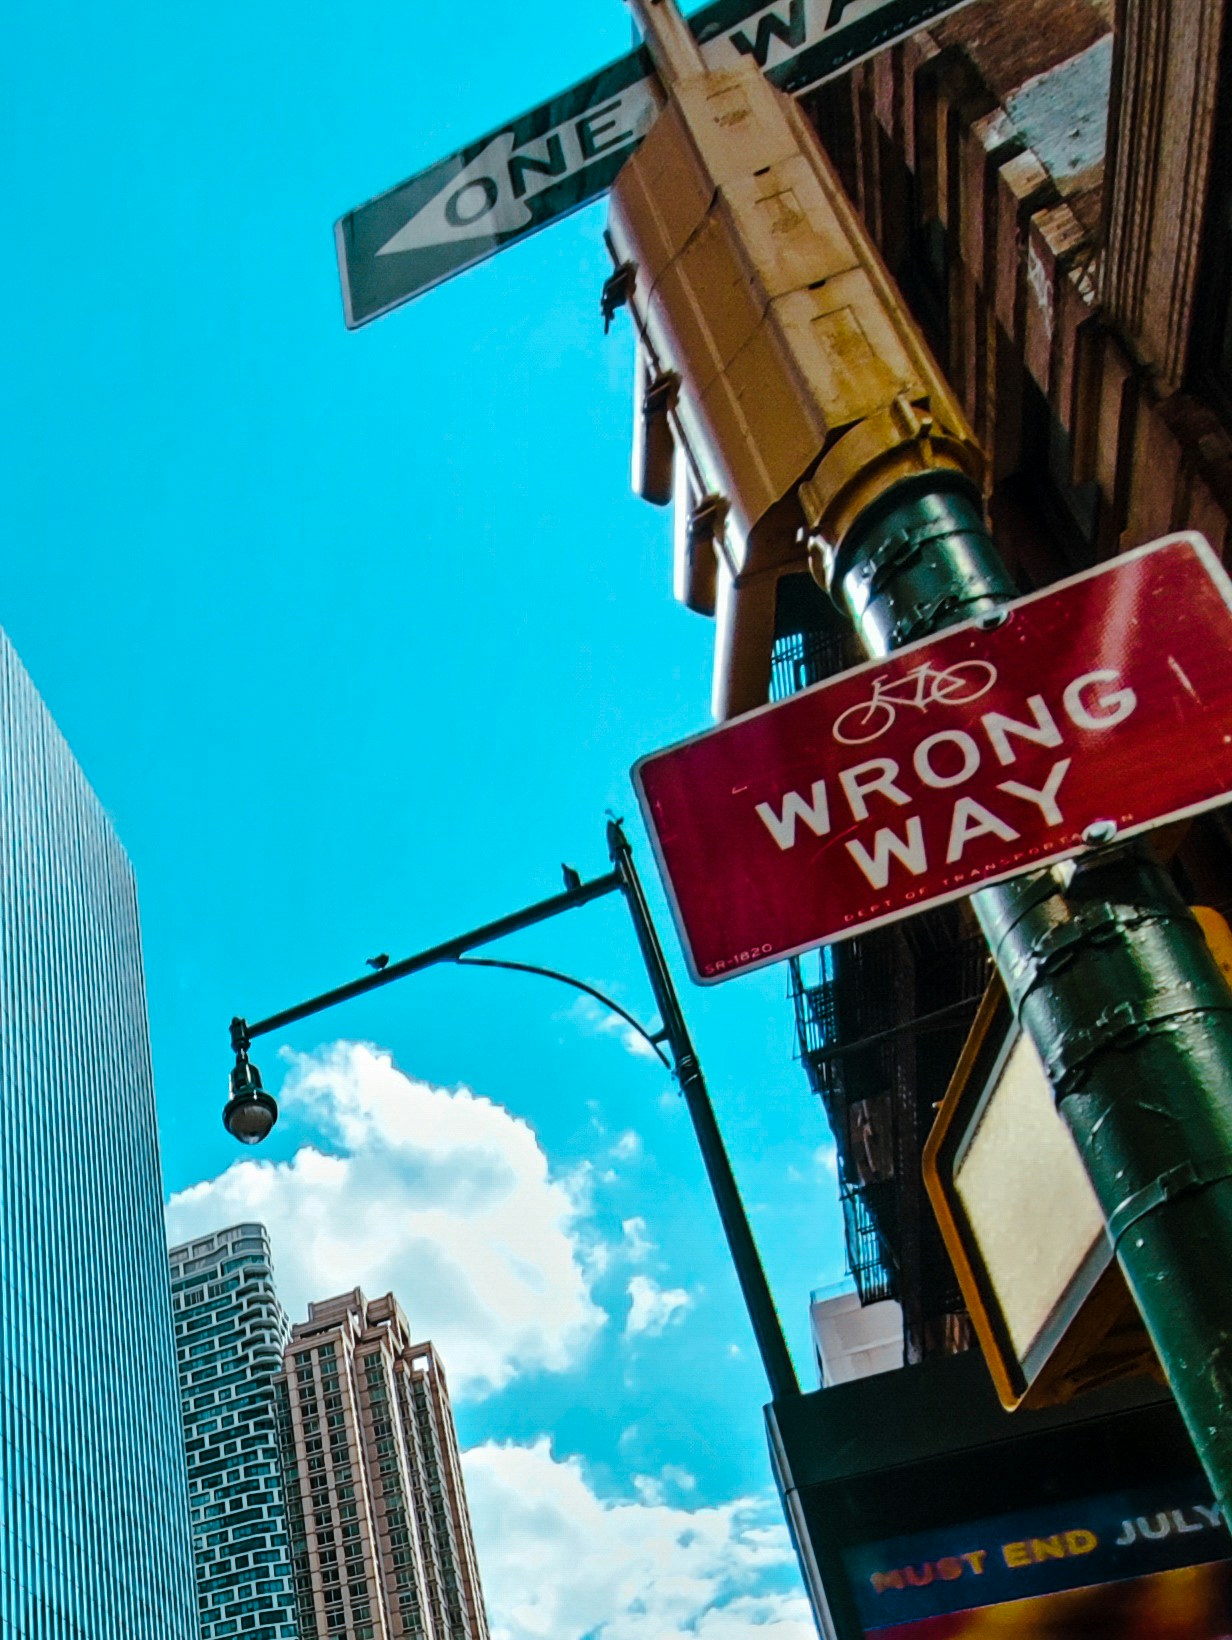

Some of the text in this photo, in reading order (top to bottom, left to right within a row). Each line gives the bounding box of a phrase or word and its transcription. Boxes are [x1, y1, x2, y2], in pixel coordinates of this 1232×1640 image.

[443, 98, 636, 228] ONE
[755, 668, 1137, 852] WRONG
[843, 813, 1134, 923] DEPT OF TRANSPORTAN
[844, 757, 1072, 891] WAY
[704, 943, 773, 975] SR-1820
[869, 1503, 1224, 1595] MUST END JULY
